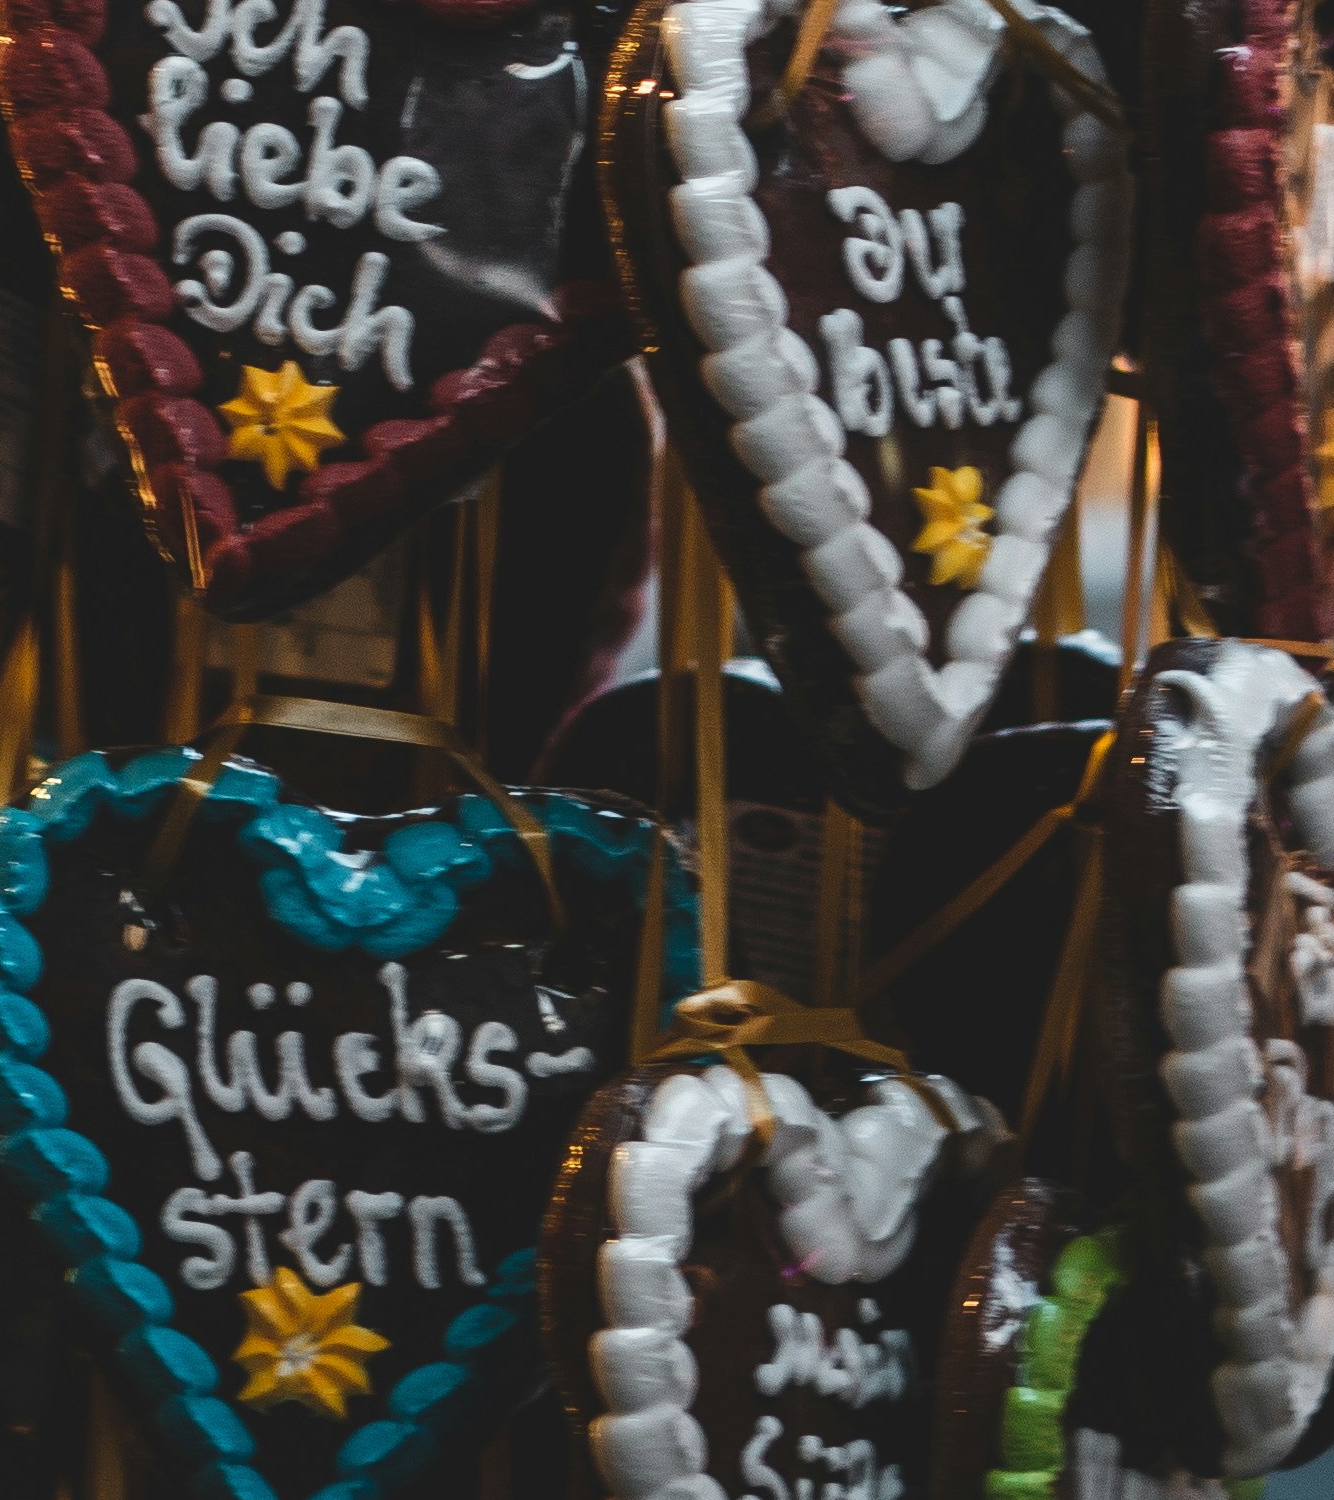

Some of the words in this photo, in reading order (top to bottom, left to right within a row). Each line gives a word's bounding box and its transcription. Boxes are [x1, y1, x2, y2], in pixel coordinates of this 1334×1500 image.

[172, 213, 416, 392] Dich
[106, 962, 595, 1182] Glücks-
[160, 1150, 487, 1291] stern
